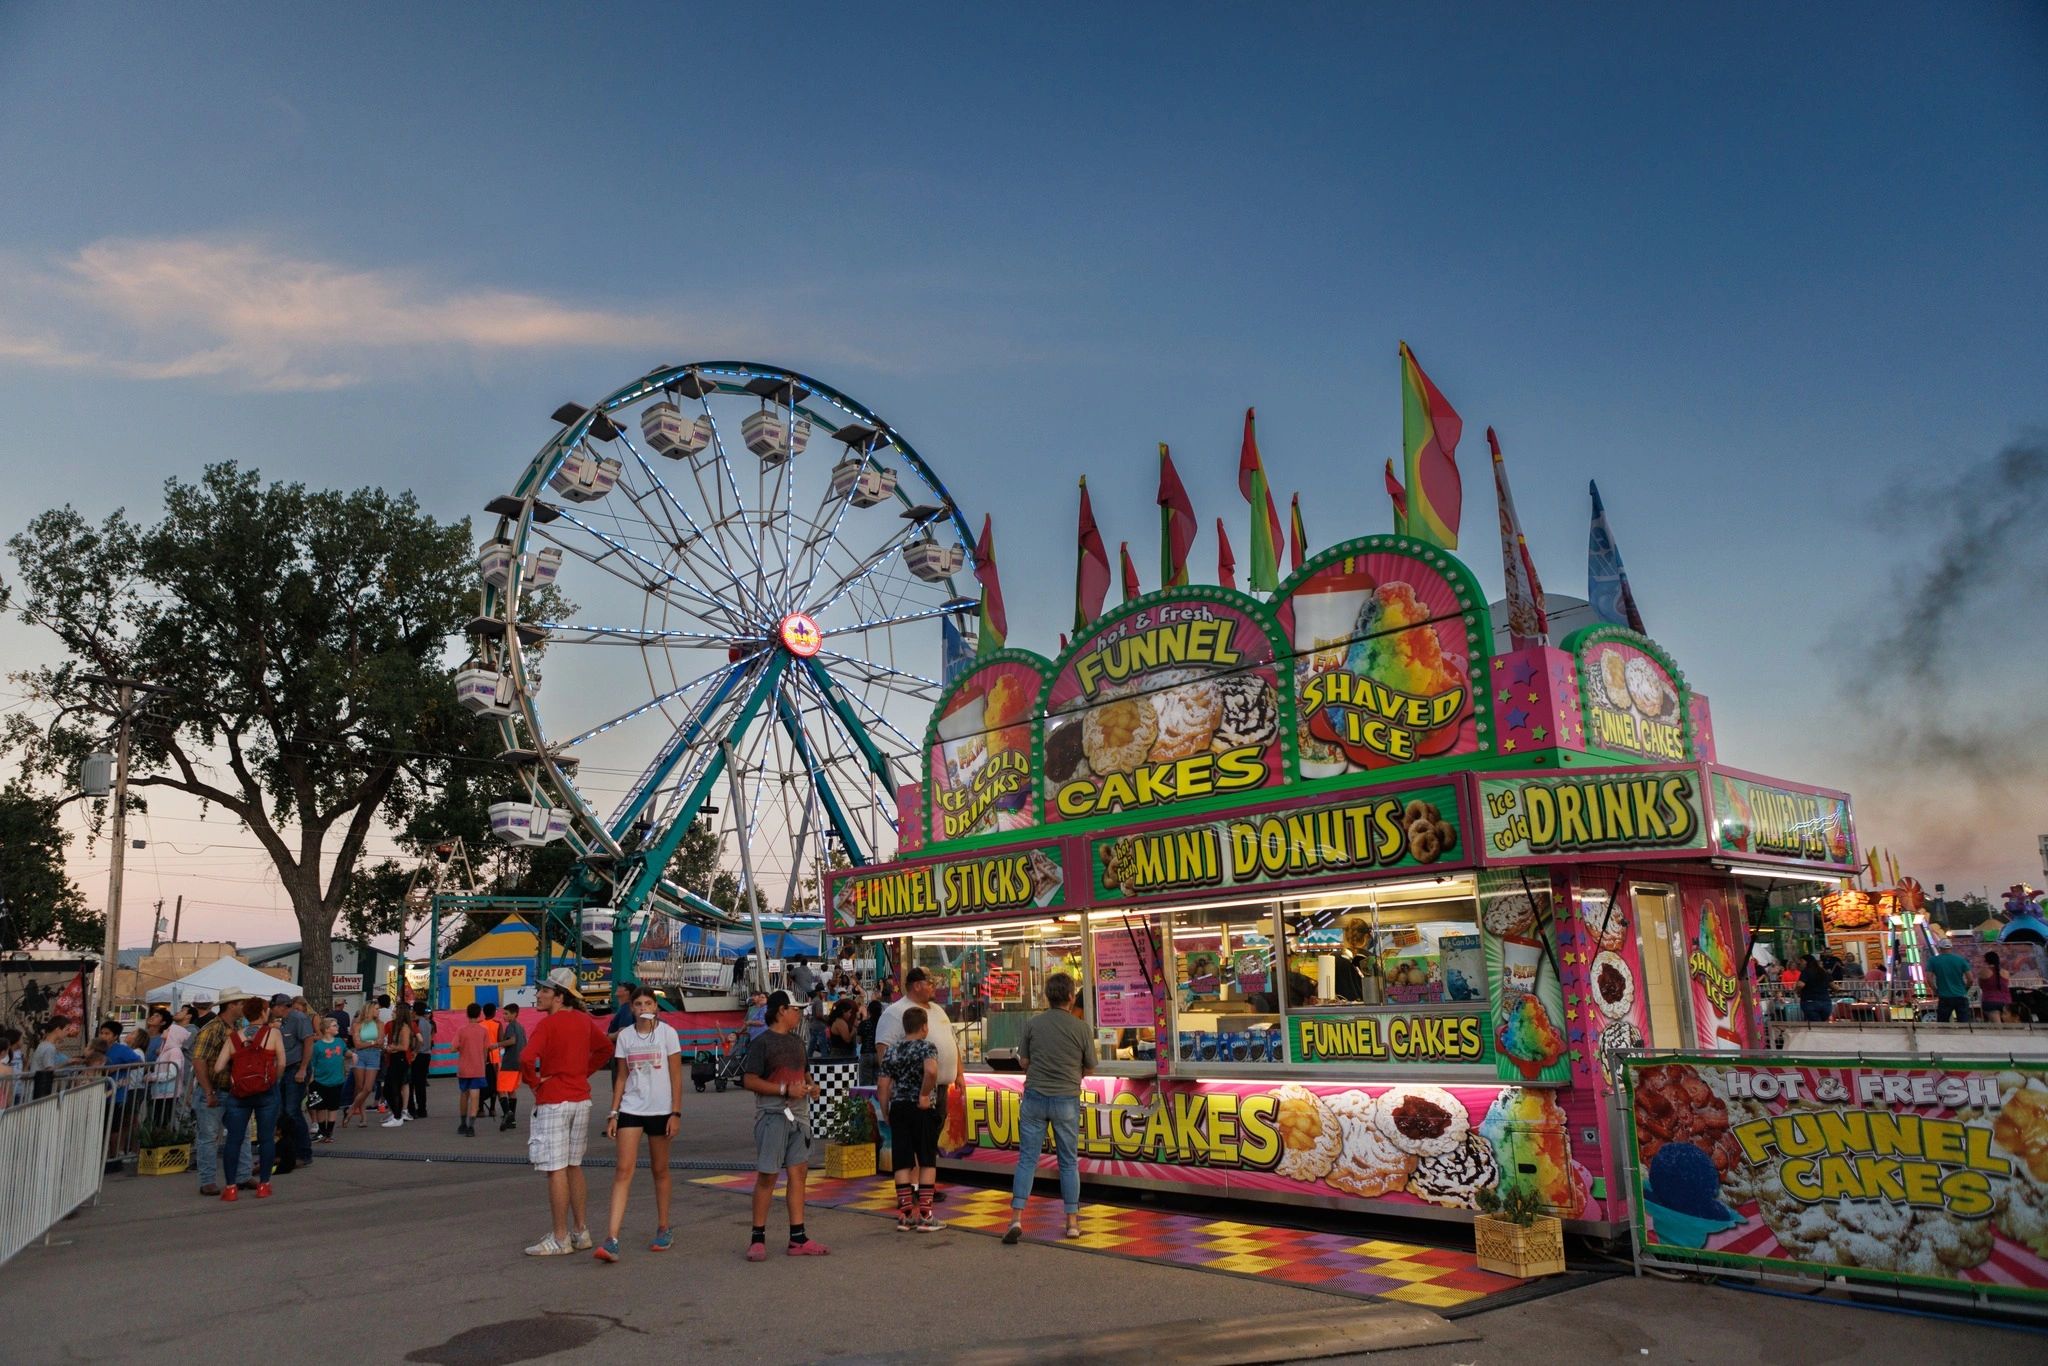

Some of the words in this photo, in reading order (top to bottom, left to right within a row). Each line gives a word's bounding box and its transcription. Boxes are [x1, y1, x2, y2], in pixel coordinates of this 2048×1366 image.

[1096, 623, 1128, 654] hot
[1135, 612, 1152, 630] &
[1159, 605, 1214, 624] fresh
[1075, 617, 1241, 698] FUNNEL
[1301, 672, 1465, 728] SHAVED
[1346, 711, 1414, 760] ICE
[1591, 705, 1641, 751] FUNNEL
[1640, 718, 1685, 760] CAKES
[934, 780, 967, 812] ICE
[973, 750, 1030, 793] COLD
[943, 772, 1020, 837] DRINKS
[1058, 744, 1268, 818] CAKES
[1488, 789, 1516, 818] ice
[1493, 814, 1532, 851] cold
[1525, 777, 1691, 847] DRINKS
[1749, 787, 1800, 850] SHAVED
[1797, 797, 1824, 852] ICE
[1115, 839, 1130, 860] hot
[1117, 858, 1138, 882] fresh
[1134, 827, 1221, 887] MINI
[1231, 799, 1404, 877] DONUTS
[856, 866, 938, 921] FUNNEL
[945, 854, 1032, 911] STICKS
[1452, 937, 1465, 946] Can
[1465, 936, 1475, 945] Do
[451, 968, 525, 978] CARICATURES
[1689, 951, 1737, 995] SHAVED
[1705, 978, 1728, 1012] ICE
[1299, 1017, 1386, 1059] FUNNEL
[1389, 1016, 1484, 1061] CAKES
[1725, 1071, 1805, 1102] HOT
[1815, 1076, 1850, 1103] &
[1859, 1074, 2002, 1108] FRESH
[1111, 1092, 1281, 1166] CAKES
[1730, 1109, 2012, 1176] FUNNEL
[1779, 1152, 1997, 1219] CAKES
